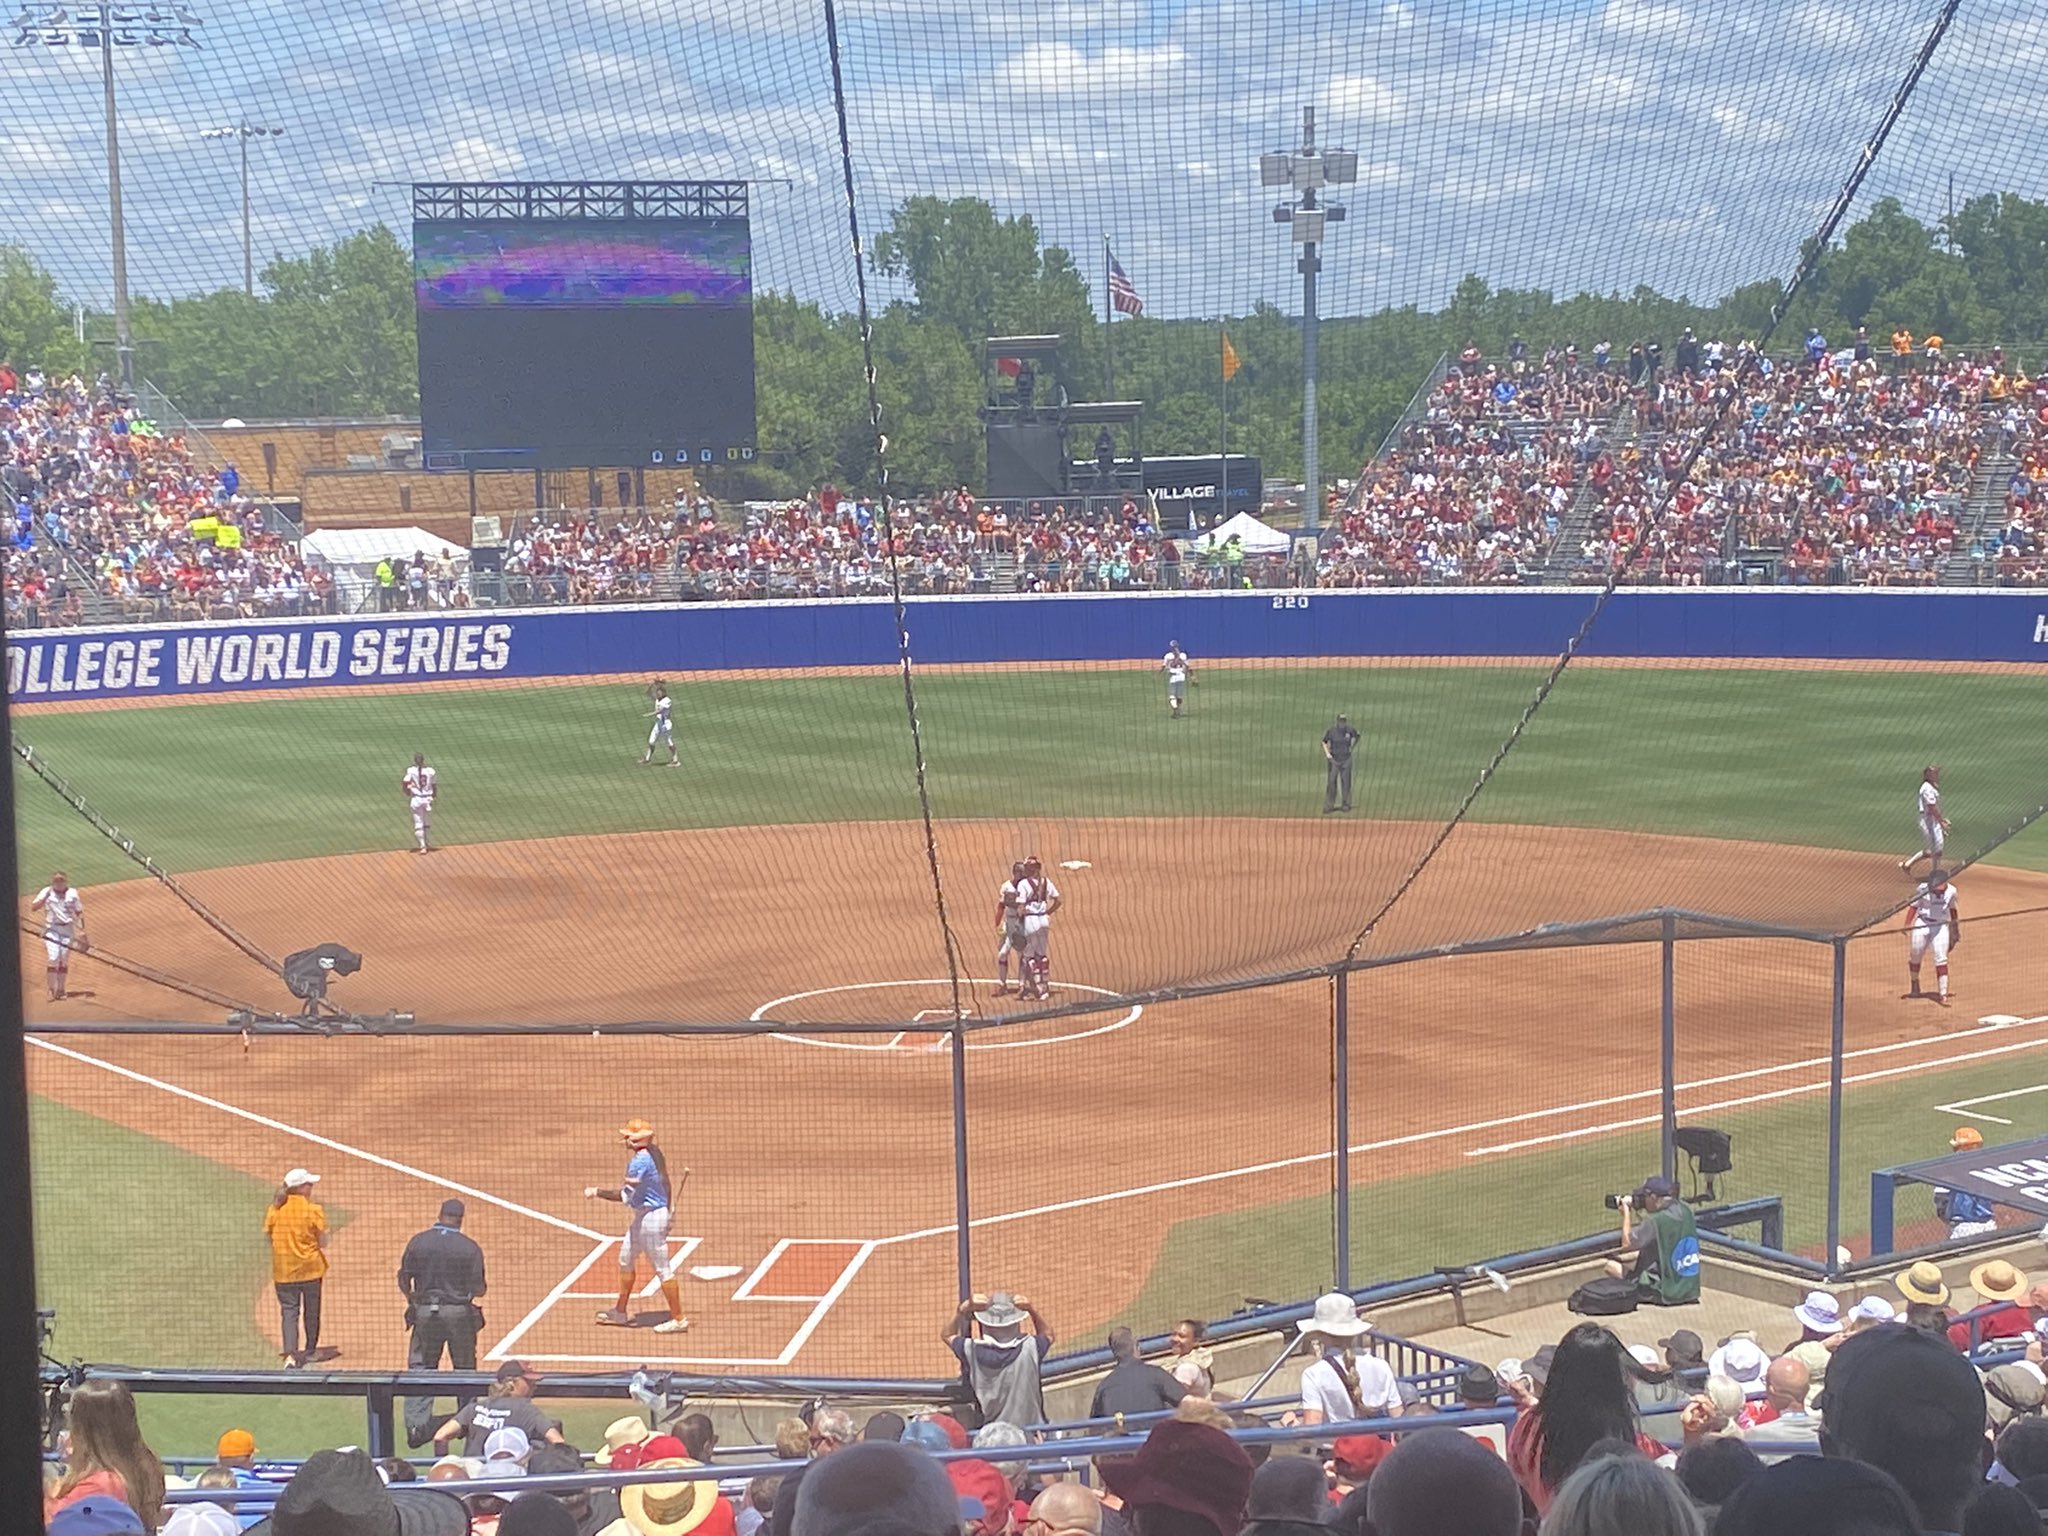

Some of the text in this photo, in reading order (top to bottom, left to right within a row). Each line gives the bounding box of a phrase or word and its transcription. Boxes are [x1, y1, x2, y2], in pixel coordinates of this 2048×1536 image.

[1147, 485, 1215, 500] VILLAGE
[1273, 596, 1309, 609] 220
[177, 631, 342, 685] WORLD
[349, 624, 513, 676] SERIES
